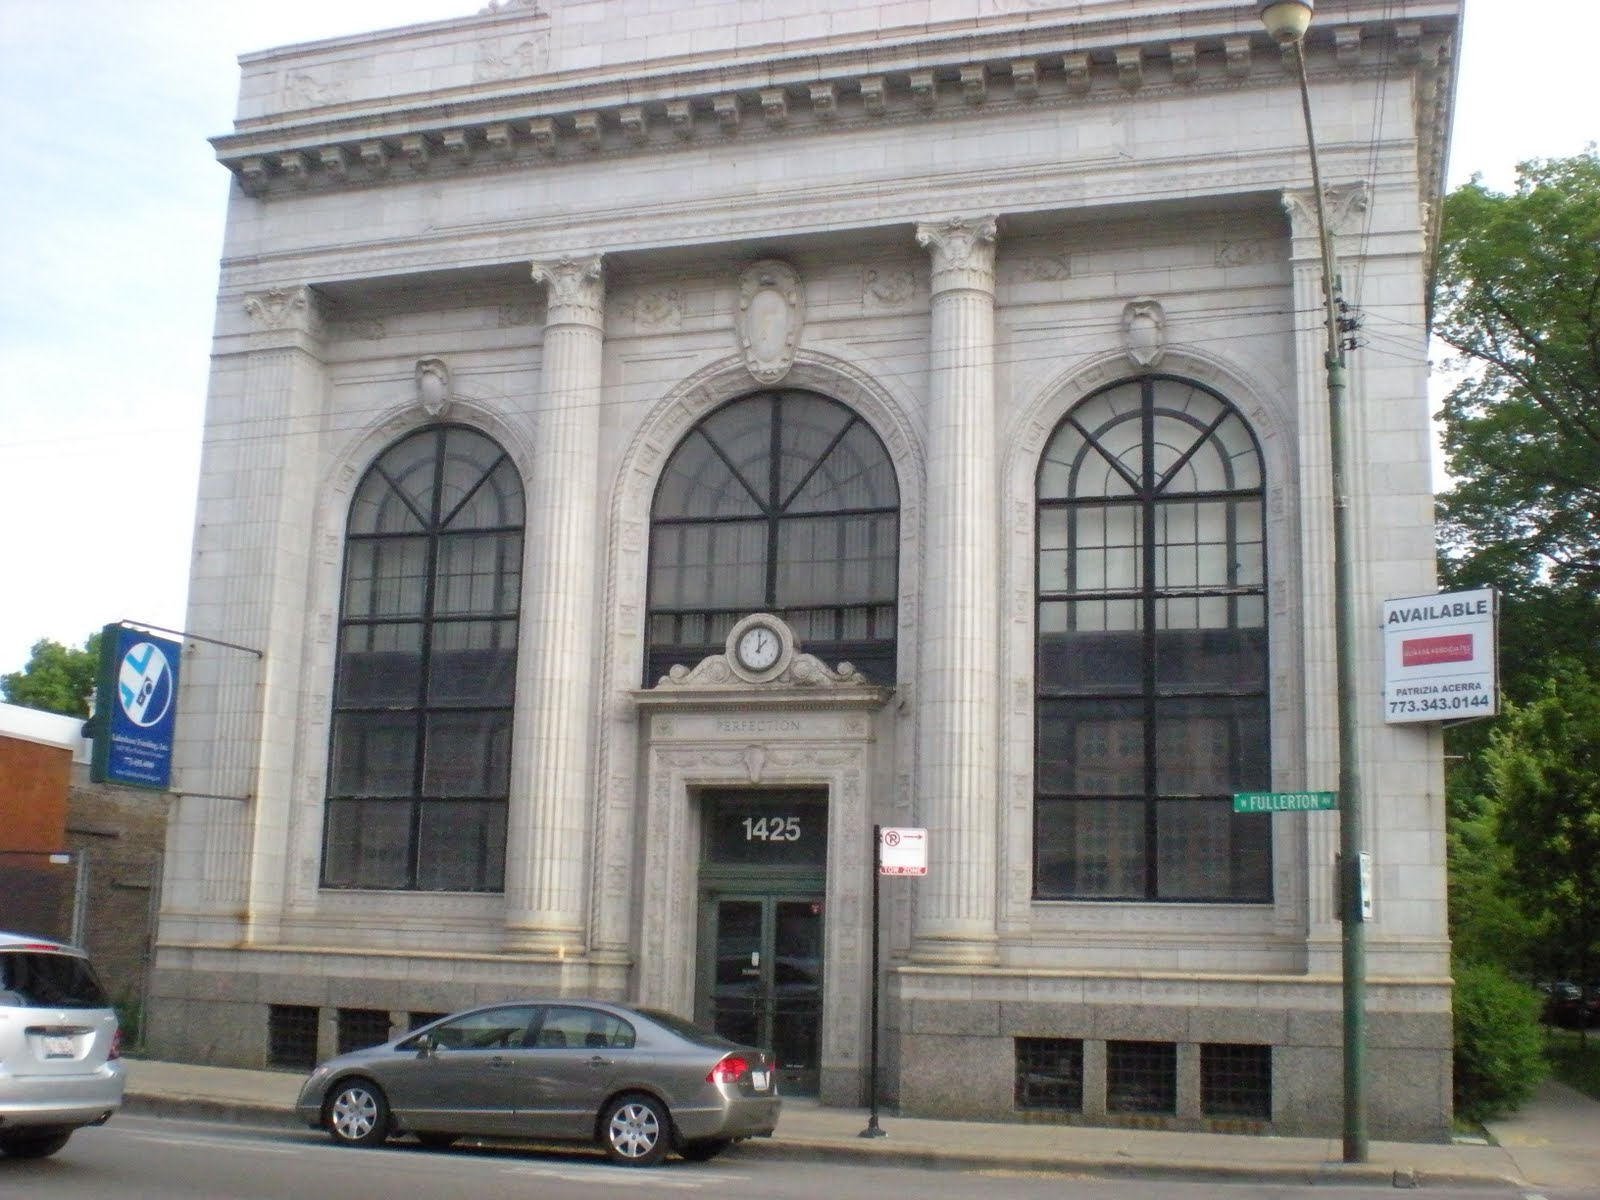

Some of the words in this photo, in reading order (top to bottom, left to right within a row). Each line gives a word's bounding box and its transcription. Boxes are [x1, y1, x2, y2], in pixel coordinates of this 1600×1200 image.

[1388, 600, 1488, 625] AVAILABLE
[1396, 686, 1439, 697] PATRIZIA
[1441, 682, 1482, 693] ACERRA
[1389, 694, 1489, 714] 773.343.0144
[716, 719, 800, 732] PERFECTION
[1250, 795, 1318, 810] FULLERTON
[742, 817, 801, 841] 1425
